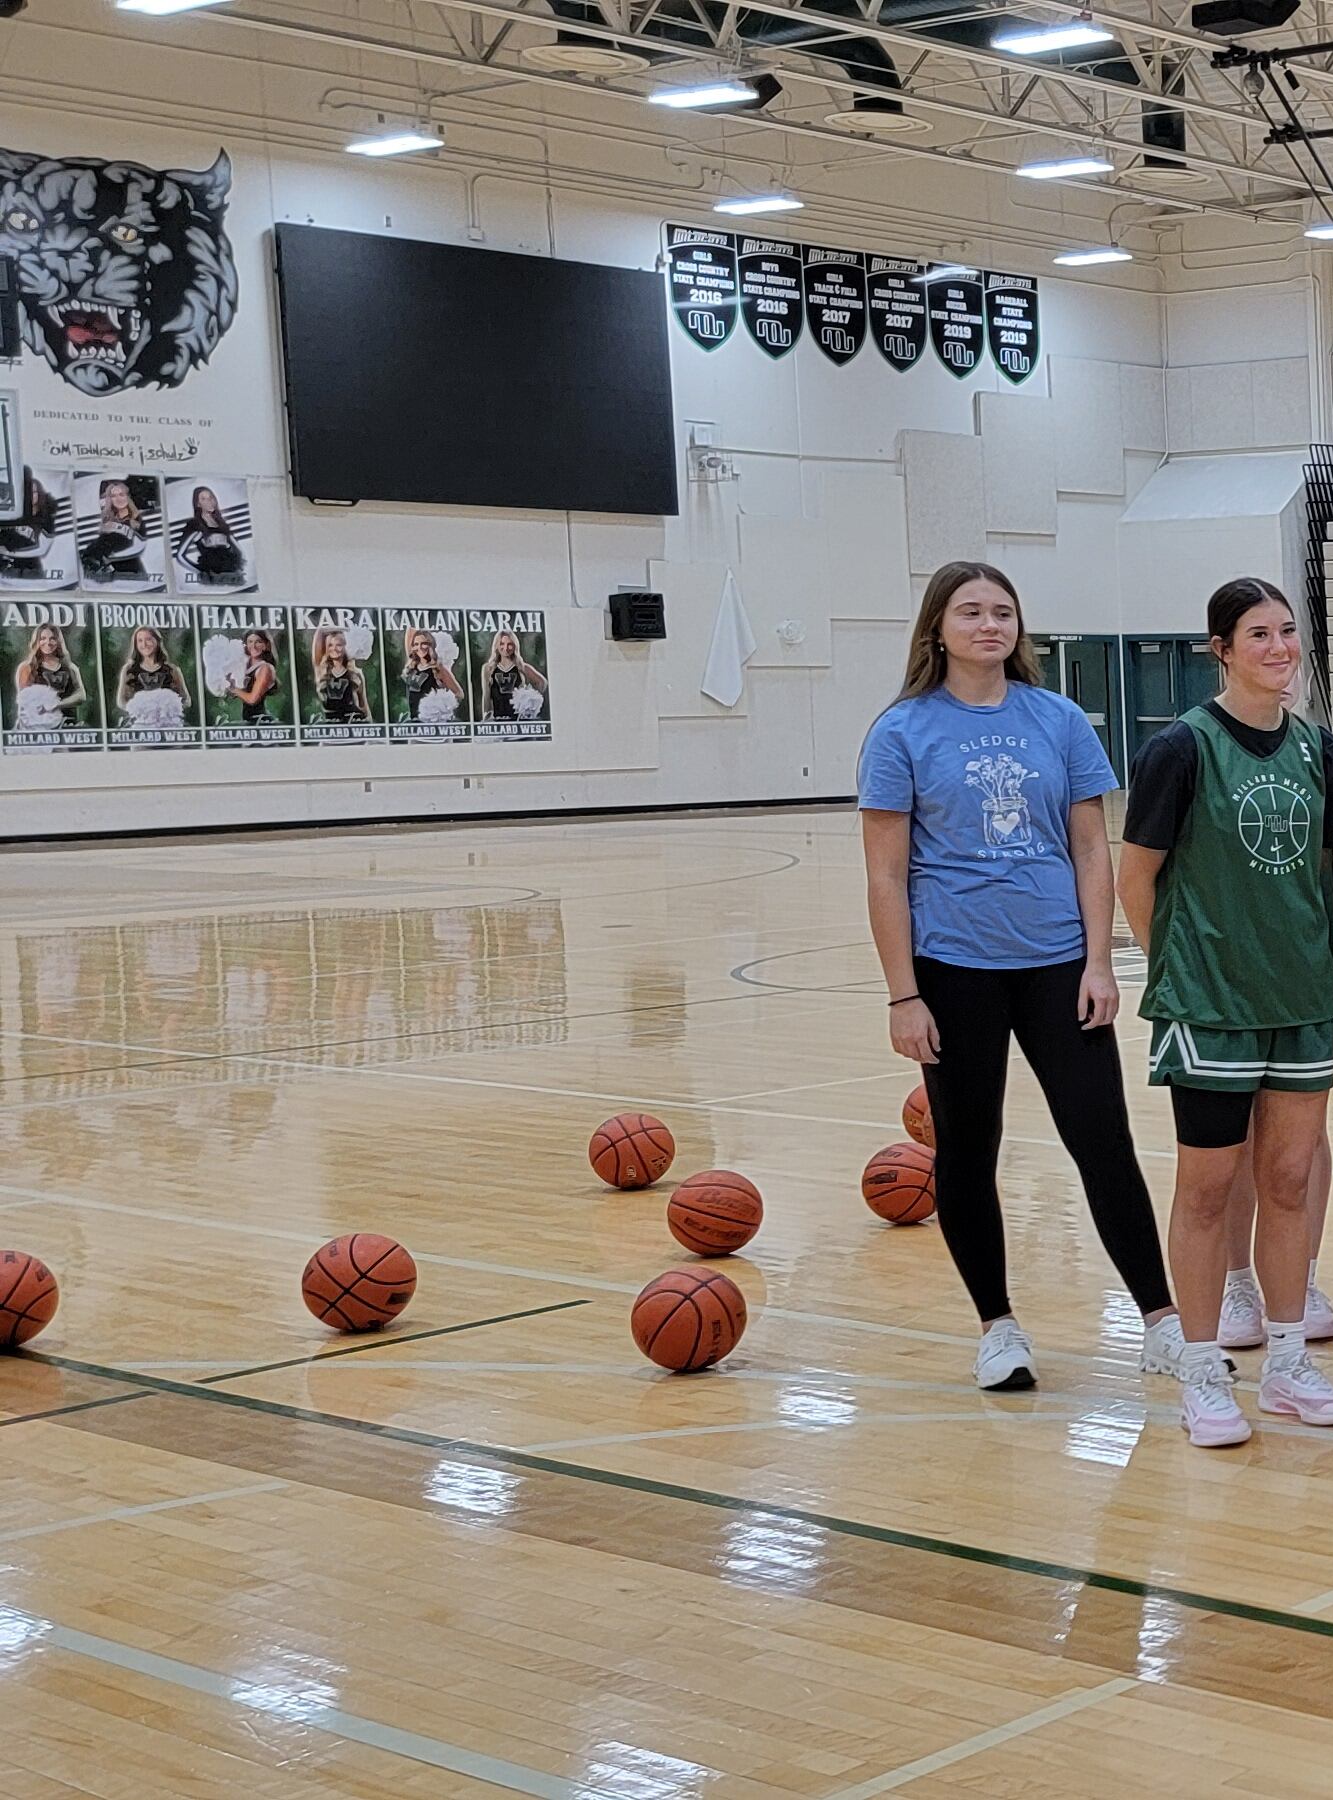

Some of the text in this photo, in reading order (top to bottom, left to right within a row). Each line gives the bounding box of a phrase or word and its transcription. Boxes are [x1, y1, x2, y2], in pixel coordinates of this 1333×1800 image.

[689, 288, 723, 305] 2016
[757, 299, 788, 315] 2016
[822, 309, 850, 324] 2017
[885, 313, 913, 329] 2017
[944, 324, 972, 339] 2019
[1000, 330, 1027, 345] 2019
[33, 410, 214, 428] DEDICATED TO THE CLASS OF
[3, 603, 87, 628] ADDI
[102, 604, 190, 628] BROOKLYN
[202, 606, 285, 629] HALLE
[296, 607, 376, 630] KARA
[385, 609, 461, 632] KAYLAN
[469, 611, 542, 633] SARAH
[112, 731, 197, 743] MILLARD WEST
[209, 729, 290, 740] MILLARD WEST
[304, 727, 381, 738] MILLARD WEST
[393, 724, 467, 736] MILLARD WEST
[477, 724, 547, 735] MILLARD WEST
[8, 732, 98, 745] MILLARD WEST
[960, 735, 1029, 752] SLEDGE
[1232, 774, 1275, 801] MILLARD
[977, 842, 1045, 859] STRONG
[1249, 858, 1304, 880] WILDCATS
